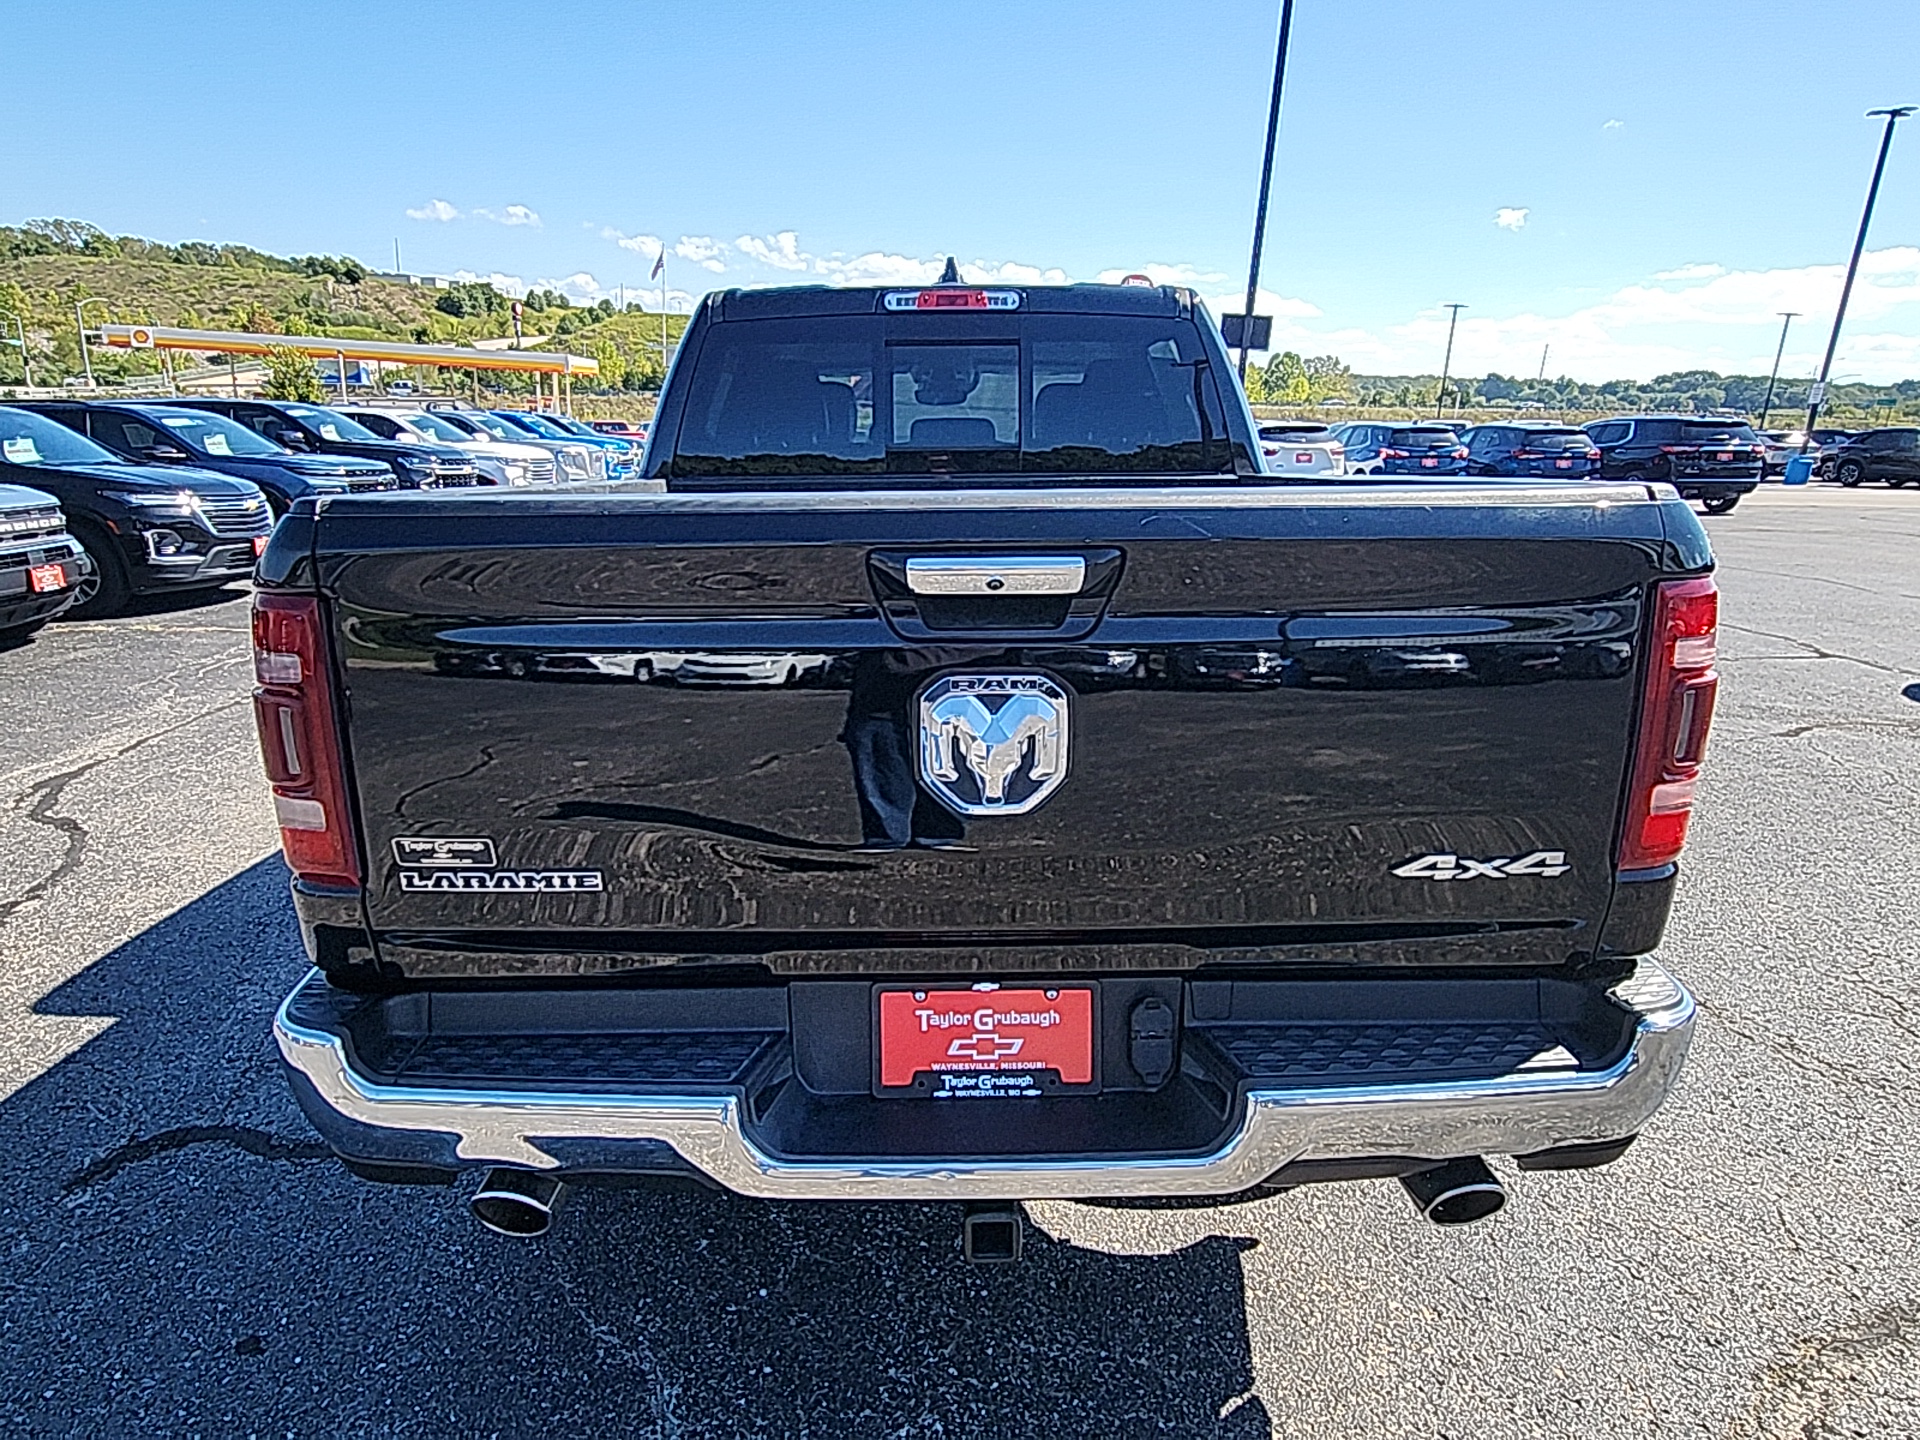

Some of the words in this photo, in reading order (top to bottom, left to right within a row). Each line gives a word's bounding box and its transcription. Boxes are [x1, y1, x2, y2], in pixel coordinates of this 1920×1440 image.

[950, 678, 1039, 692] RAM
[400, 872, 603, 892] LARAMIE
[915, 1009, 971, 1032] Taylor
[973, 1008, 1061, 1031] Grubaugh
[930, 1062, 999, 1071] WAYNESVILLE,
[1000, 1061, 1046, 1070] MISSOURI
[940, 1074, 978, 1090] Taylor
[978, 1074, 1034, 1089] Grubaugh
